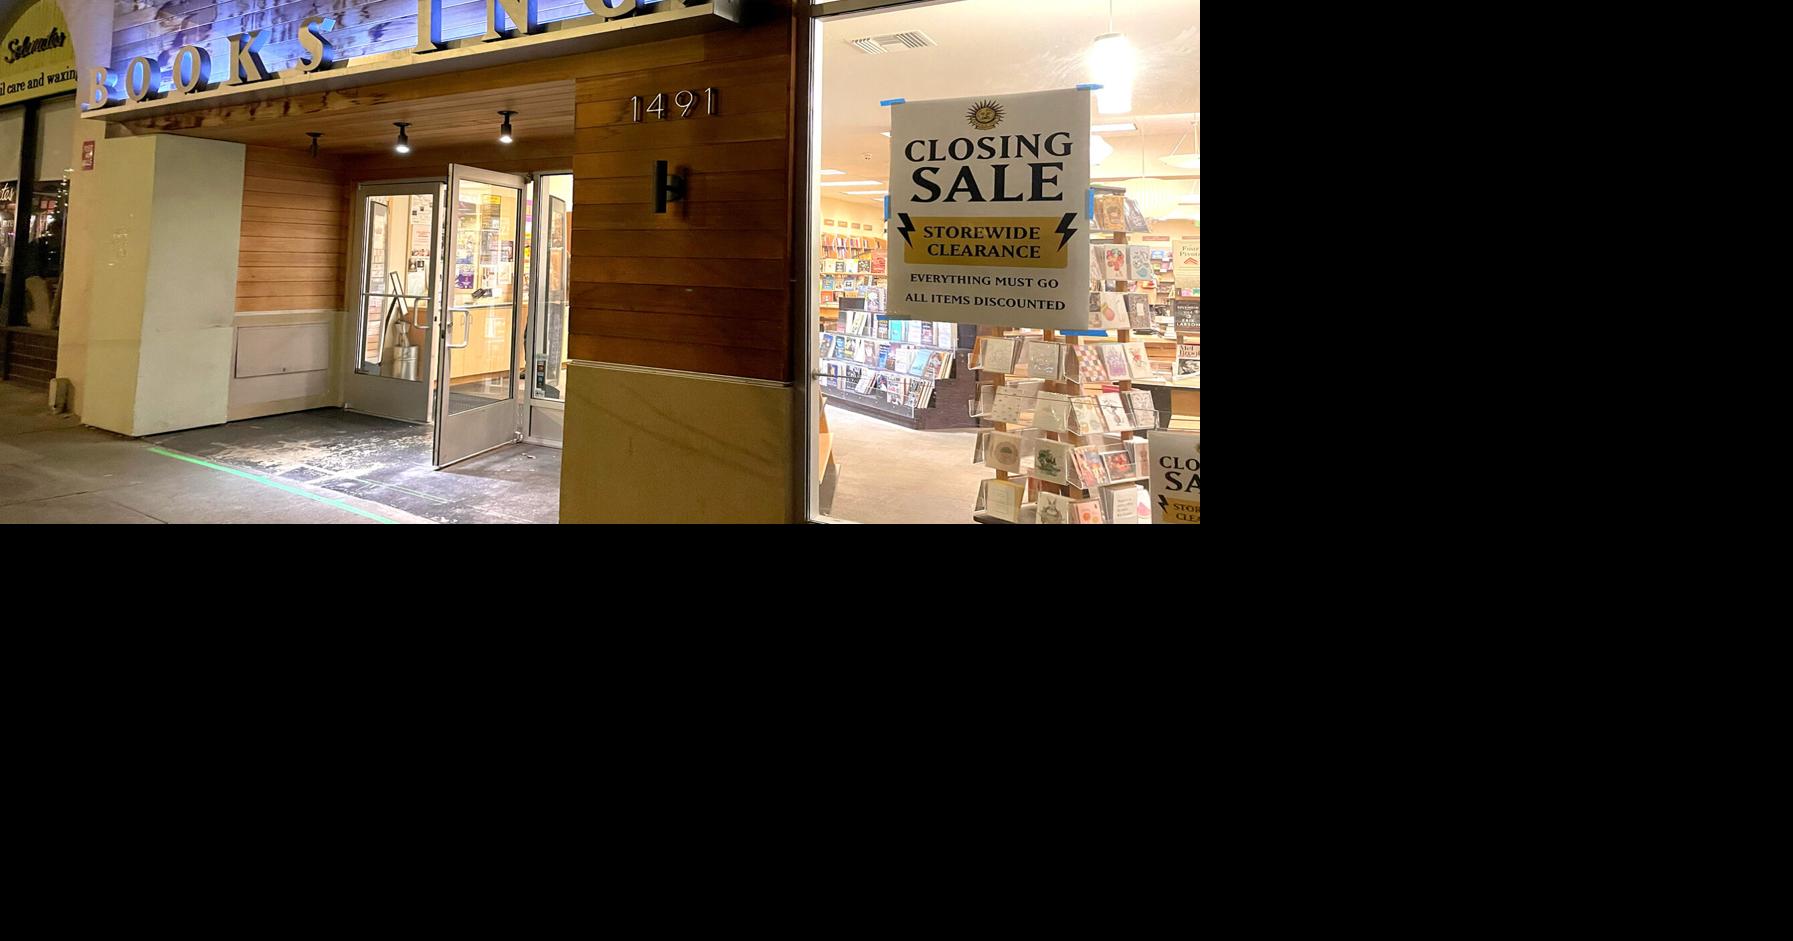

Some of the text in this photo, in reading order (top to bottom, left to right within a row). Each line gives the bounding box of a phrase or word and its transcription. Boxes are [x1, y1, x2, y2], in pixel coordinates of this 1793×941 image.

[87, 0, 636, 110] BOOKS IN
[7, 81, 26, 94] care
[27, 72, 45, 90] and
[630, 87, 717, 123] 1491
[904, 131, 1073, 162] CLOSING
[910, 162, 1064, 203] SALE
[923, 225, 1041, 240] STOREWIDE
[927, 243, 1041, 259] CLEARANCE
[910, 273, 1059, 289] EVERYTHING MUST GO
[905, 293, 1066, 311] ALL ITEMS DISCOUNTED
